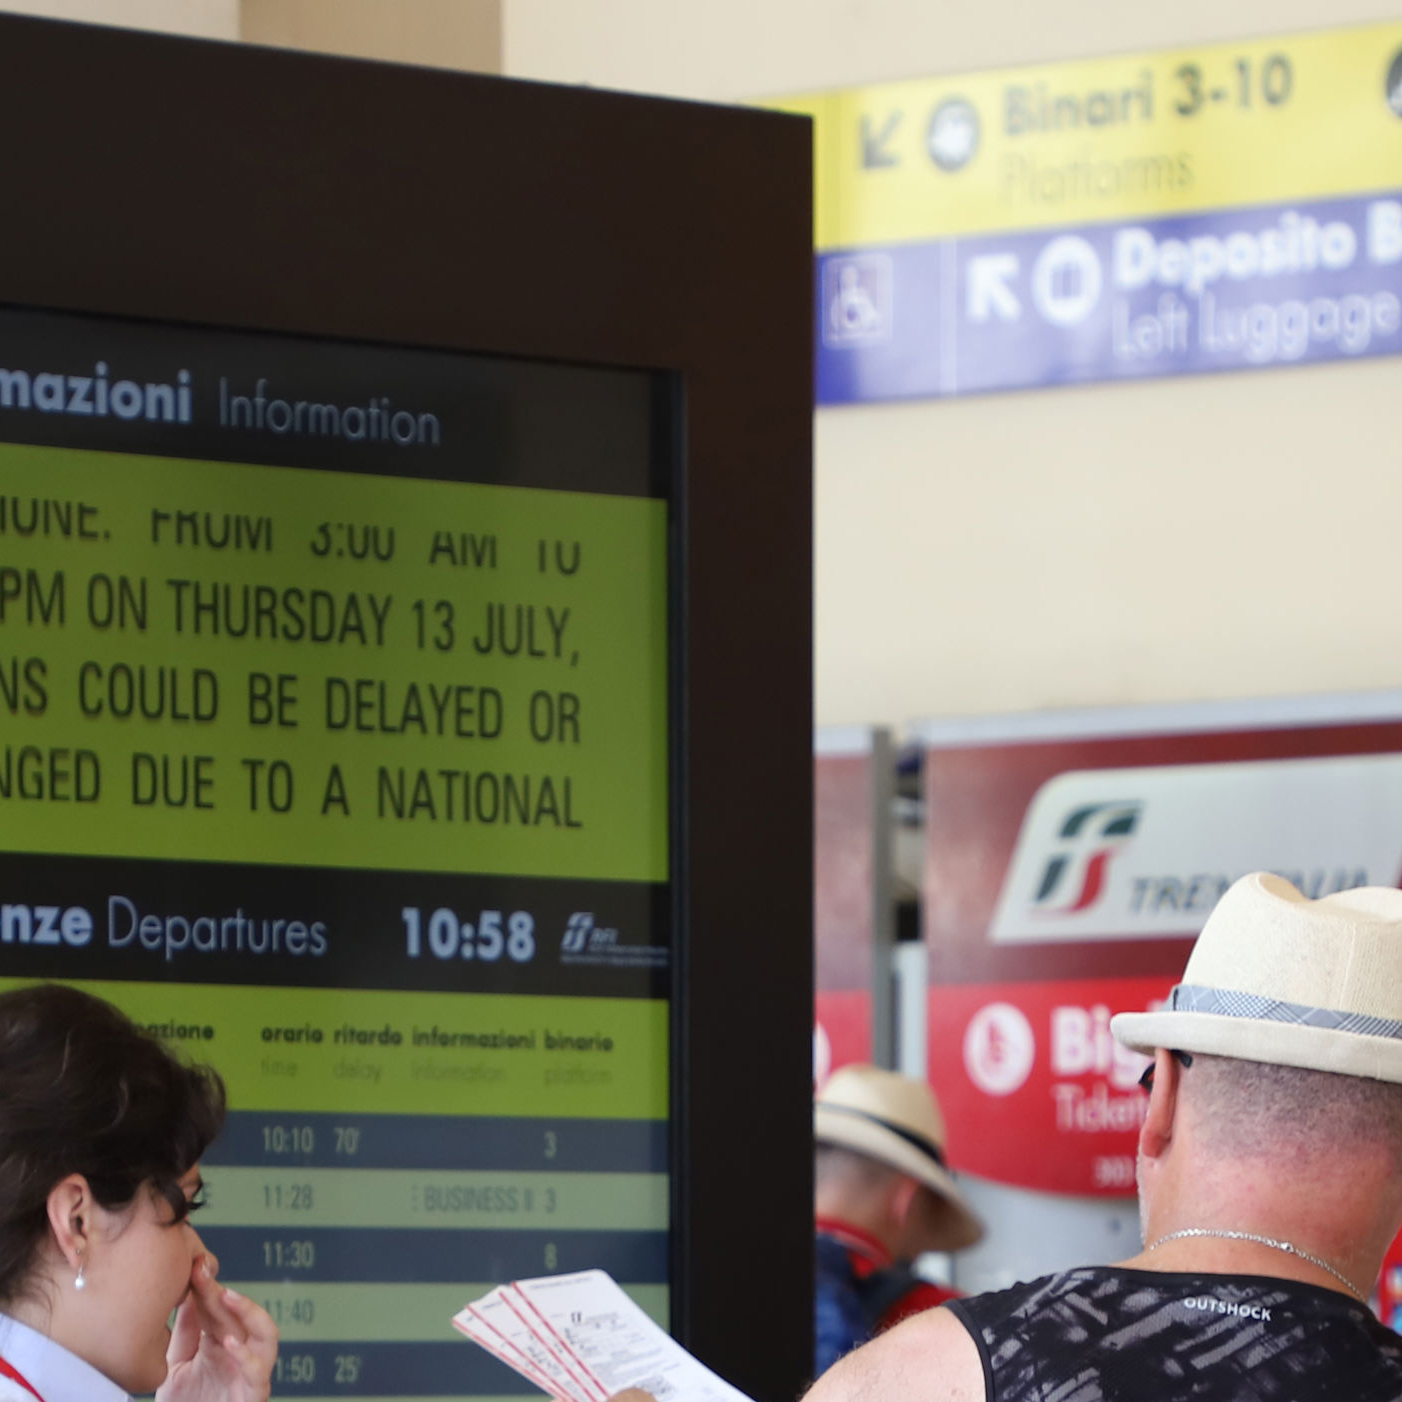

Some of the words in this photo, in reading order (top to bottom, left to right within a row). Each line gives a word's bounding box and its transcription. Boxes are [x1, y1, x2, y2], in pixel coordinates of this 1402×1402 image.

[1003, 68, 1154, 136] Binari
[1170, 54, 1295, 118] 3-10
[1113, 210, 1356, 296] Deposito
[1115, 298, 1188, 358] Left
[1203, 290, 1402, 364] Luggage
[219, 376, 441, 444] Information
[87, 572, 147, 631] ON
[166, 578, 393, 647] THURSDAY
[412, 599, 456, 651] 13
[473, 602, 580, 668] JULY,
[78, 660, 219, 722] COULD
[248, 672, 298, 728] BE
[325, 676, 503, 740] DELAYED
[529, 690, 581, 744] OR
[132, 752, 215, 810] DUE
[241, 758, 294, 814] TO
[321, 763, 350, 816] A
[378, 766, 583, 828] NATIONAL
[108, 895, 328, 961] Departures
[402, 906, 536, 963] 10:58
[261, 1023, 323, 1045] orario
[334, 1024, 402, 1047] ritardo
[412, 1026, 536, 1051] informazioni
[544, 1030, 613, 1053] binario
[262, 1126, 315, 1153] 10:10
[543, 1131, 558, 1158] 3
[262, 1183, 315, 1210] 11:28
[423, 1185, 520, 1213] BUSINESS
[544, 1186, 557, 1213] 3
[262, 1241, 315, 1269] 11:30
[1183, 1296, 1272, 1321] OUTSHOCK
[275, 1356, 315, 1383] 1:50
